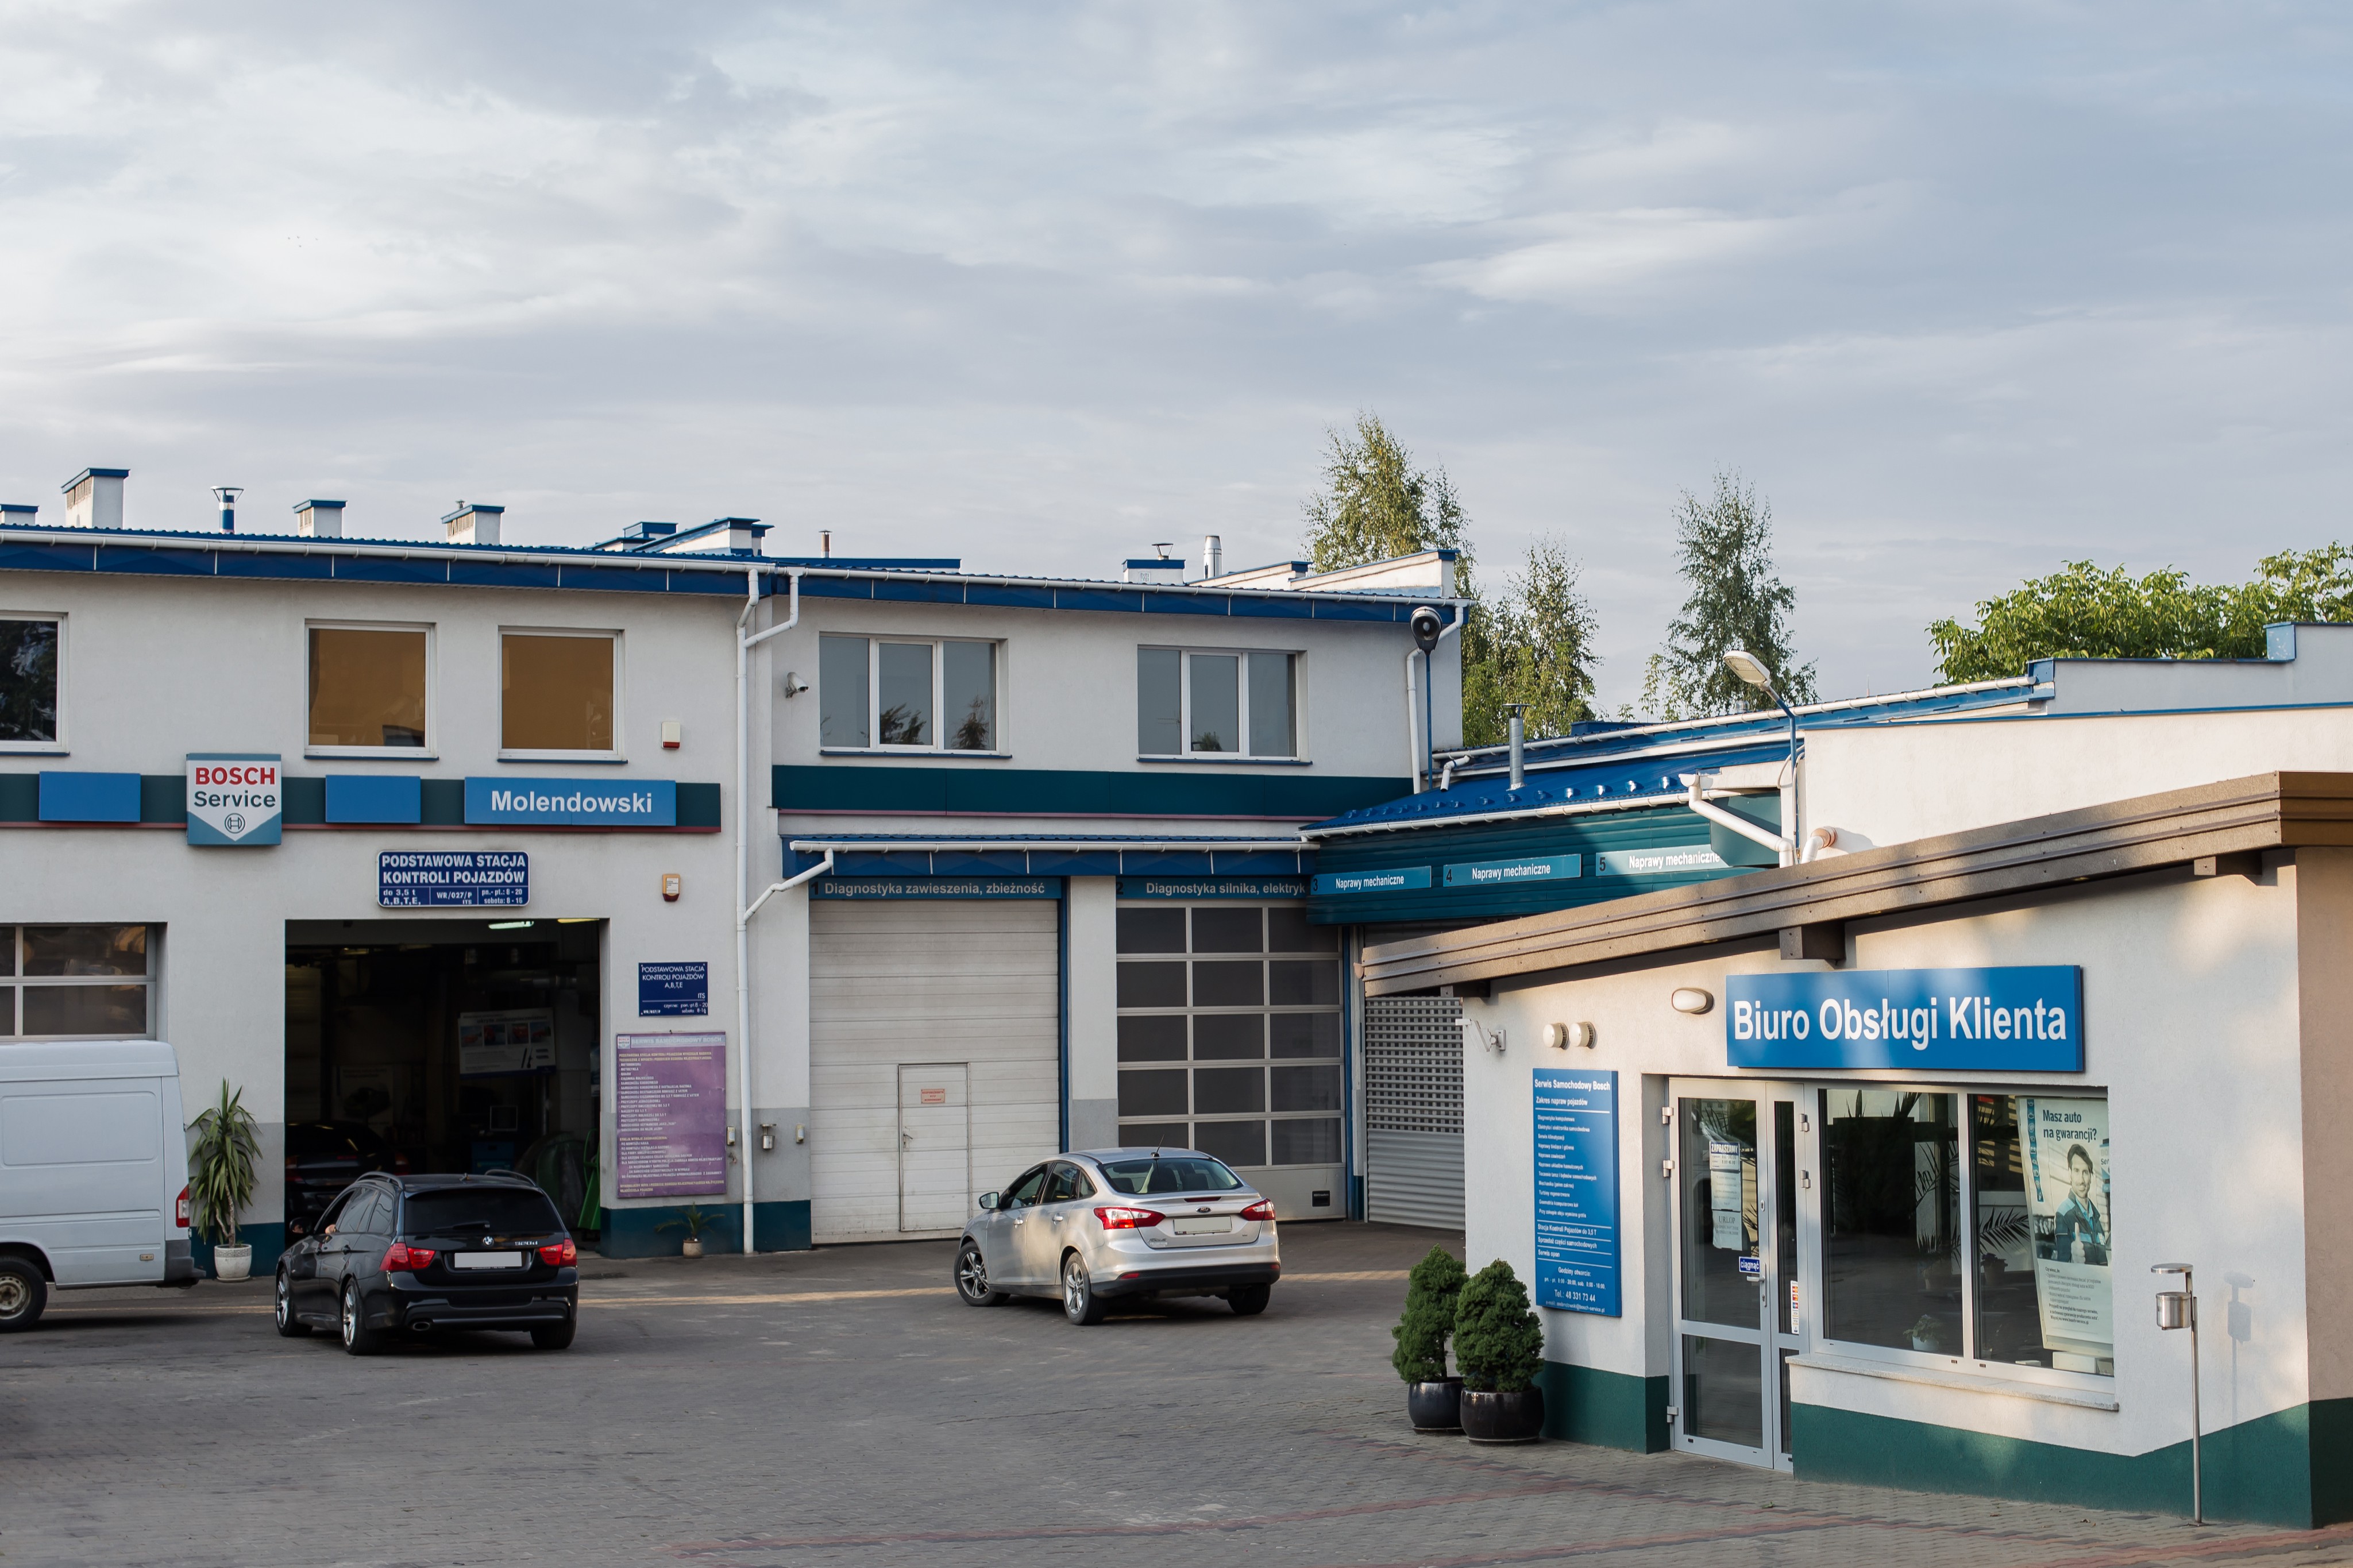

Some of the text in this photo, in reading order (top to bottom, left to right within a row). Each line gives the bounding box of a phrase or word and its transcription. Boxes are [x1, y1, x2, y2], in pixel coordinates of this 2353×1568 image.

[196, 767, 275, 785] BOSCH
[194, 790, 276, 807] Service
[492, 791, 651, 813] Molendowski
[382, 855, 526, 867] PODSTAWOWA STACJA
[1599, 851, 1720, 871] 5 Naprawy mechaniczne
[383, 868, 524, 883] KONTROLI POJAZDÓW
[1446, 862, 1550, 883] 4 Naprawy mechaniczne
[811, 882, 1044, 896] 1 Diagnostyka zawieszenia, zbieżność
[1116, 882, 1305, 896] 2 Diagnostyka silnika, elektryk
[1313, 874, 1404, 891] 3 Naprawy mechaniczne
[437, 891, 472, 899] WR/027/P
[1734, 997, 2066, 1051] Biuro Obsługi Klienta
[1535, 1079, 1610, 1091] Serwis Samochodowy Bosch
[1551, 1098, 1567, 1106] napraw
[1567, 1098, 1588, 1107] pojazdów
[2043, 1110, 2082, 1123] Masz auto
[2043, 1128, 2097, 1143] na gwarancji?
[1711, 1144, 1738, 1153] ZAPRASZAMY
[1719, 1216, 1735, 1225] URLOP
[1538, 1223, 1549, 1231] Stacja
[1564, 1226, 1581, 1234] Pojazdów
[1555, 1238, 1566, 1246] części
[1567, 1240, 1597, 1249] samochodowych
[1559, 1266, 1573, 1276] Godziny
[1741, 1260, 1759, 1271] ciągnąć
[1554, 1289, 1595, 1302] Tel.: 48 331 73 44
